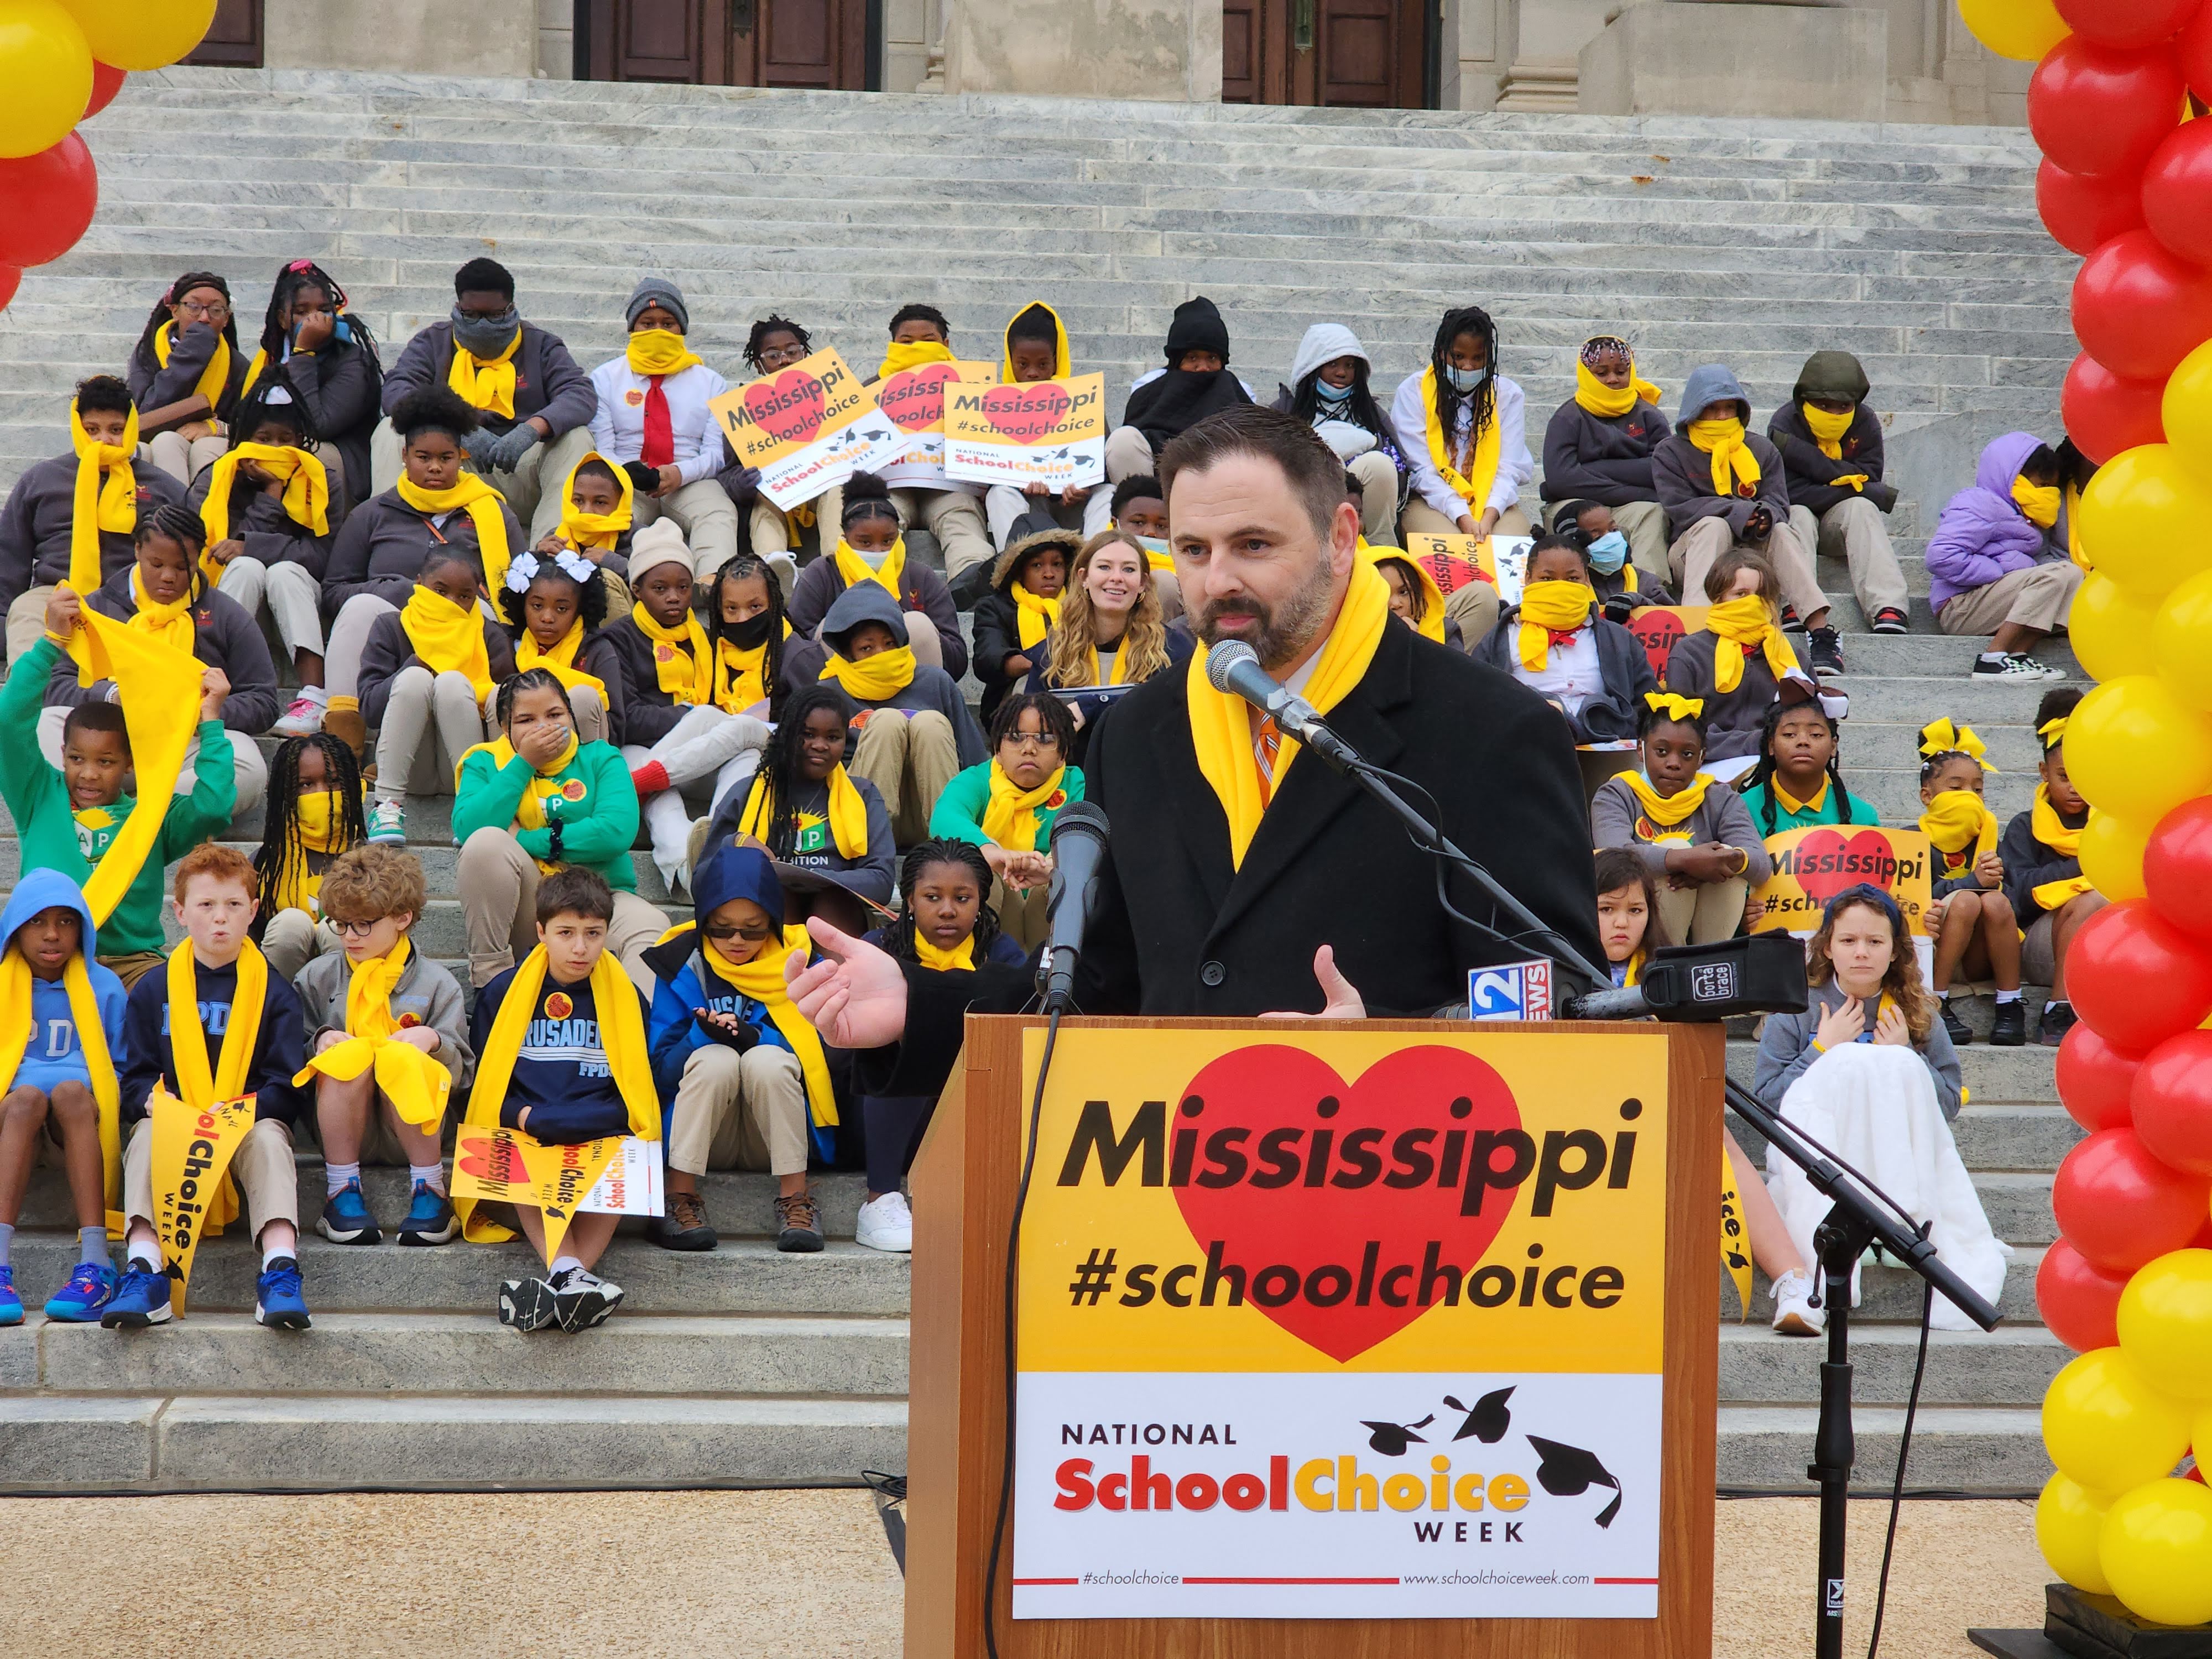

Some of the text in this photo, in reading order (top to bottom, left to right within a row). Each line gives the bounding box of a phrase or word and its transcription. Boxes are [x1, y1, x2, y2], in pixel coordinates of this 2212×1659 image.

[727, 361, 844, 431] Mississippi
[953, 385, 1097, 415] Mississippi
[747, 394, 860, 456] #schoolchoice
[957, 418, 1094, 435] #schoolchoice
[851, 449, 875, 465] WEEK
[956, 448, 1000, 458] NATIONAL
[765, 463, 804, 484] NATIONAL
[1770, 844, 1923, 886] Mississippi
[1703, 967, 1715, 997] porta
[1715, 967, 1730, 995] brace
[592, 1140, 603, 1162] TIONAL
[1056, 1094, 1642, 1217] Mississippi
[541, 1183, 554, 1201] WEEK
[593, 1186, 602, 1207] NATIONAL
[162, 1192, 175, 1244] WEEK
[1069, 1240, 1625, 1309] #schoolchoice
[1061, 1423, 1237, 1445] NATIONAL
[1413, 1522, 1524, 1543] WEEK
[1082, 1569, 1179, 1584] #schoolchoice
[1404, 1569, 1590, 1584] www.schoolchoiceweek.com
